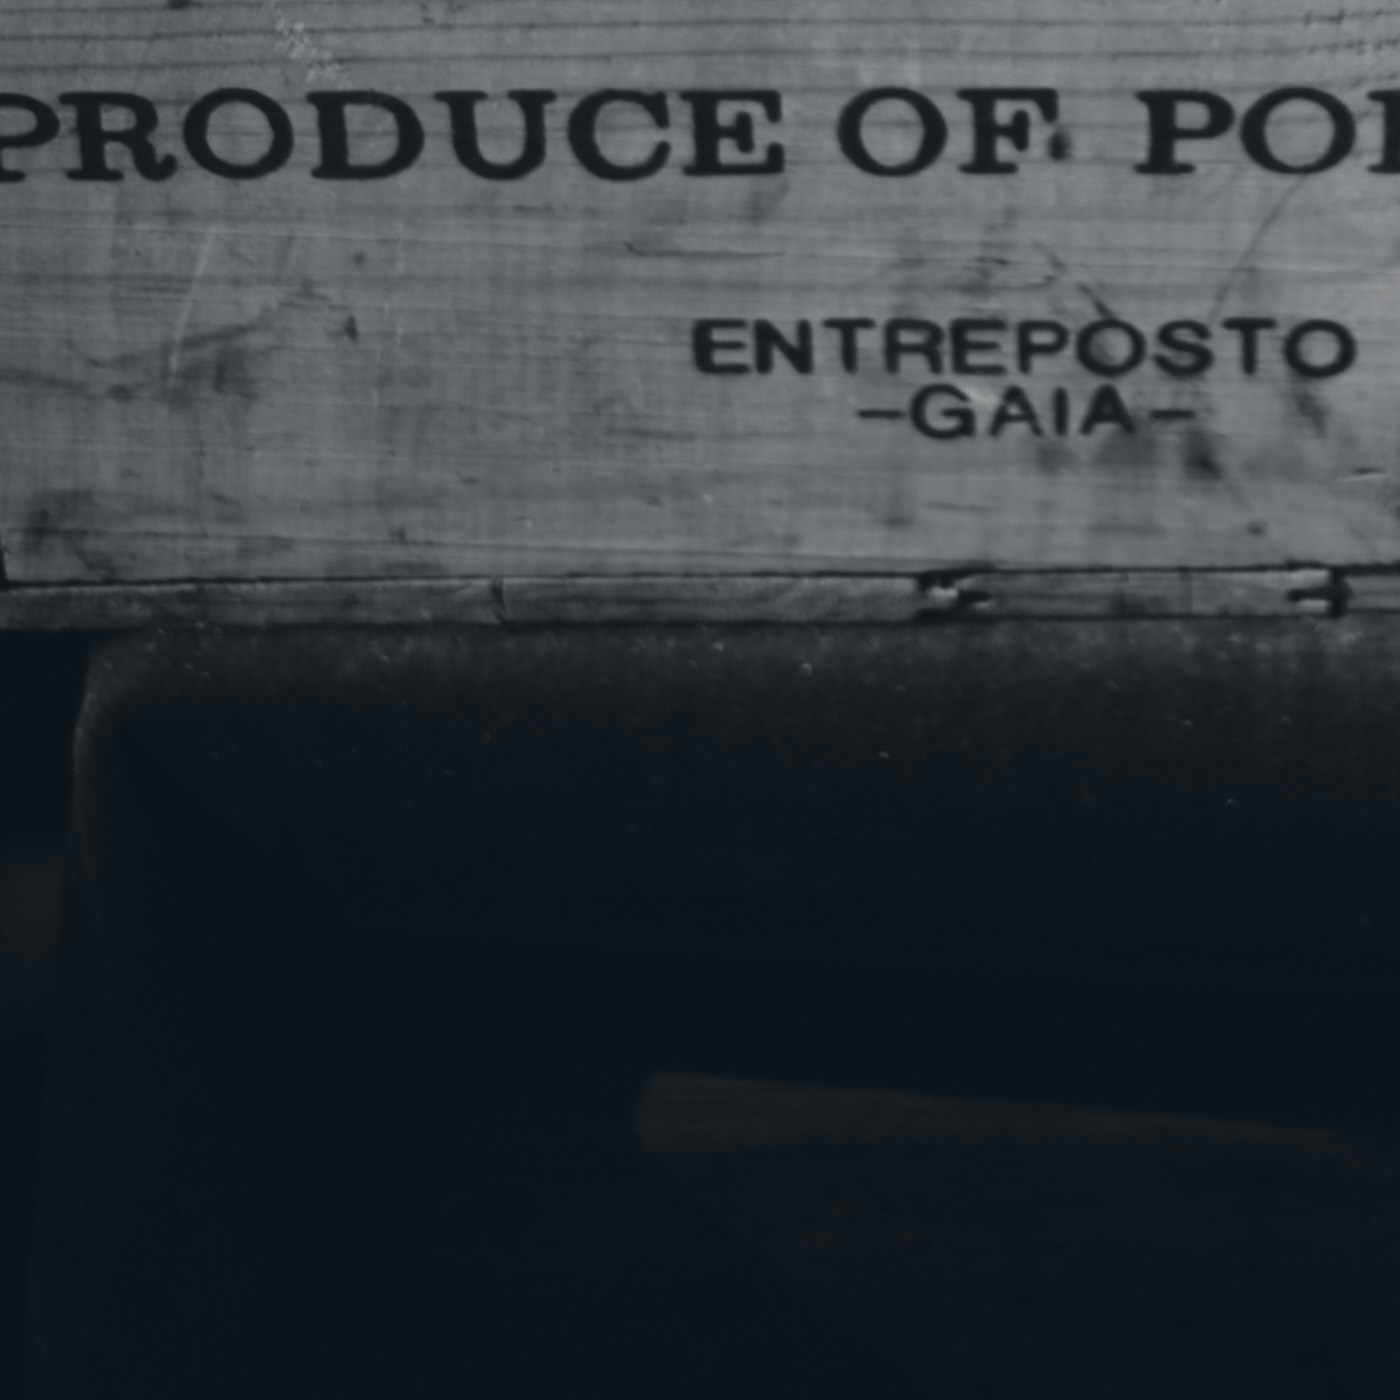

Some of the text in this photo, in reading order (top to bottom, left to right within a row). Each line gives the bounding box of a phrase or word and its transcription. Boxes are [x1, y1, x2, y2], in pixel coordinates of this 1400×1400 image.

[0, 86, 785, 182] PRODUCE
[836, 86, 1060, 178] OF
[691, 316, 1357, 379] ENTREPOSTO
